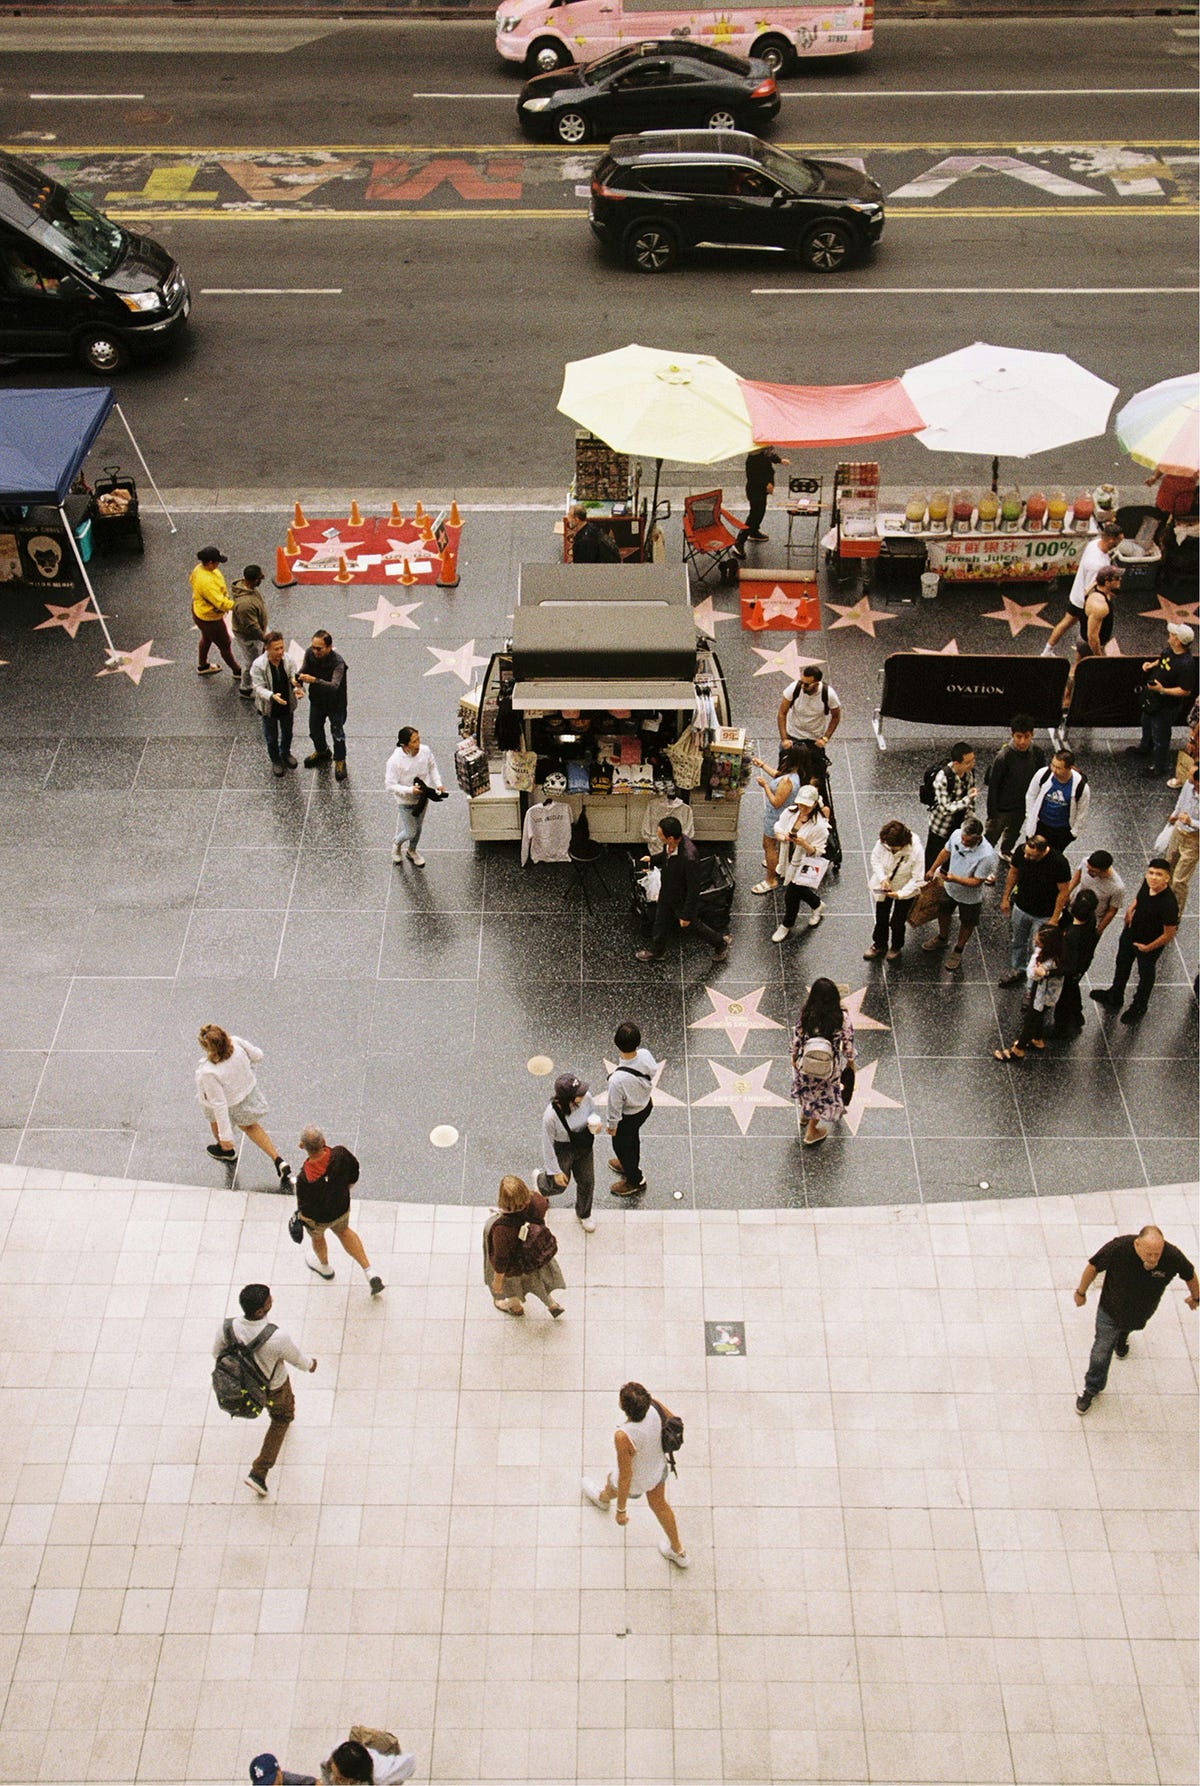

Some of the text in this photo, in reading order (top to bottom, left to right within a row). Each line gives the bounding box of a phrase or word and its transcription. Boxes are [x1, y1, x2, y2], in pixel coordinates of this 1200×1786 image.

[945, 541, 1018, 554] 新鮮果汁
[1024, 541, 1077, 557] 100%
[944, 554, 1019, 563] Fresh Juice
